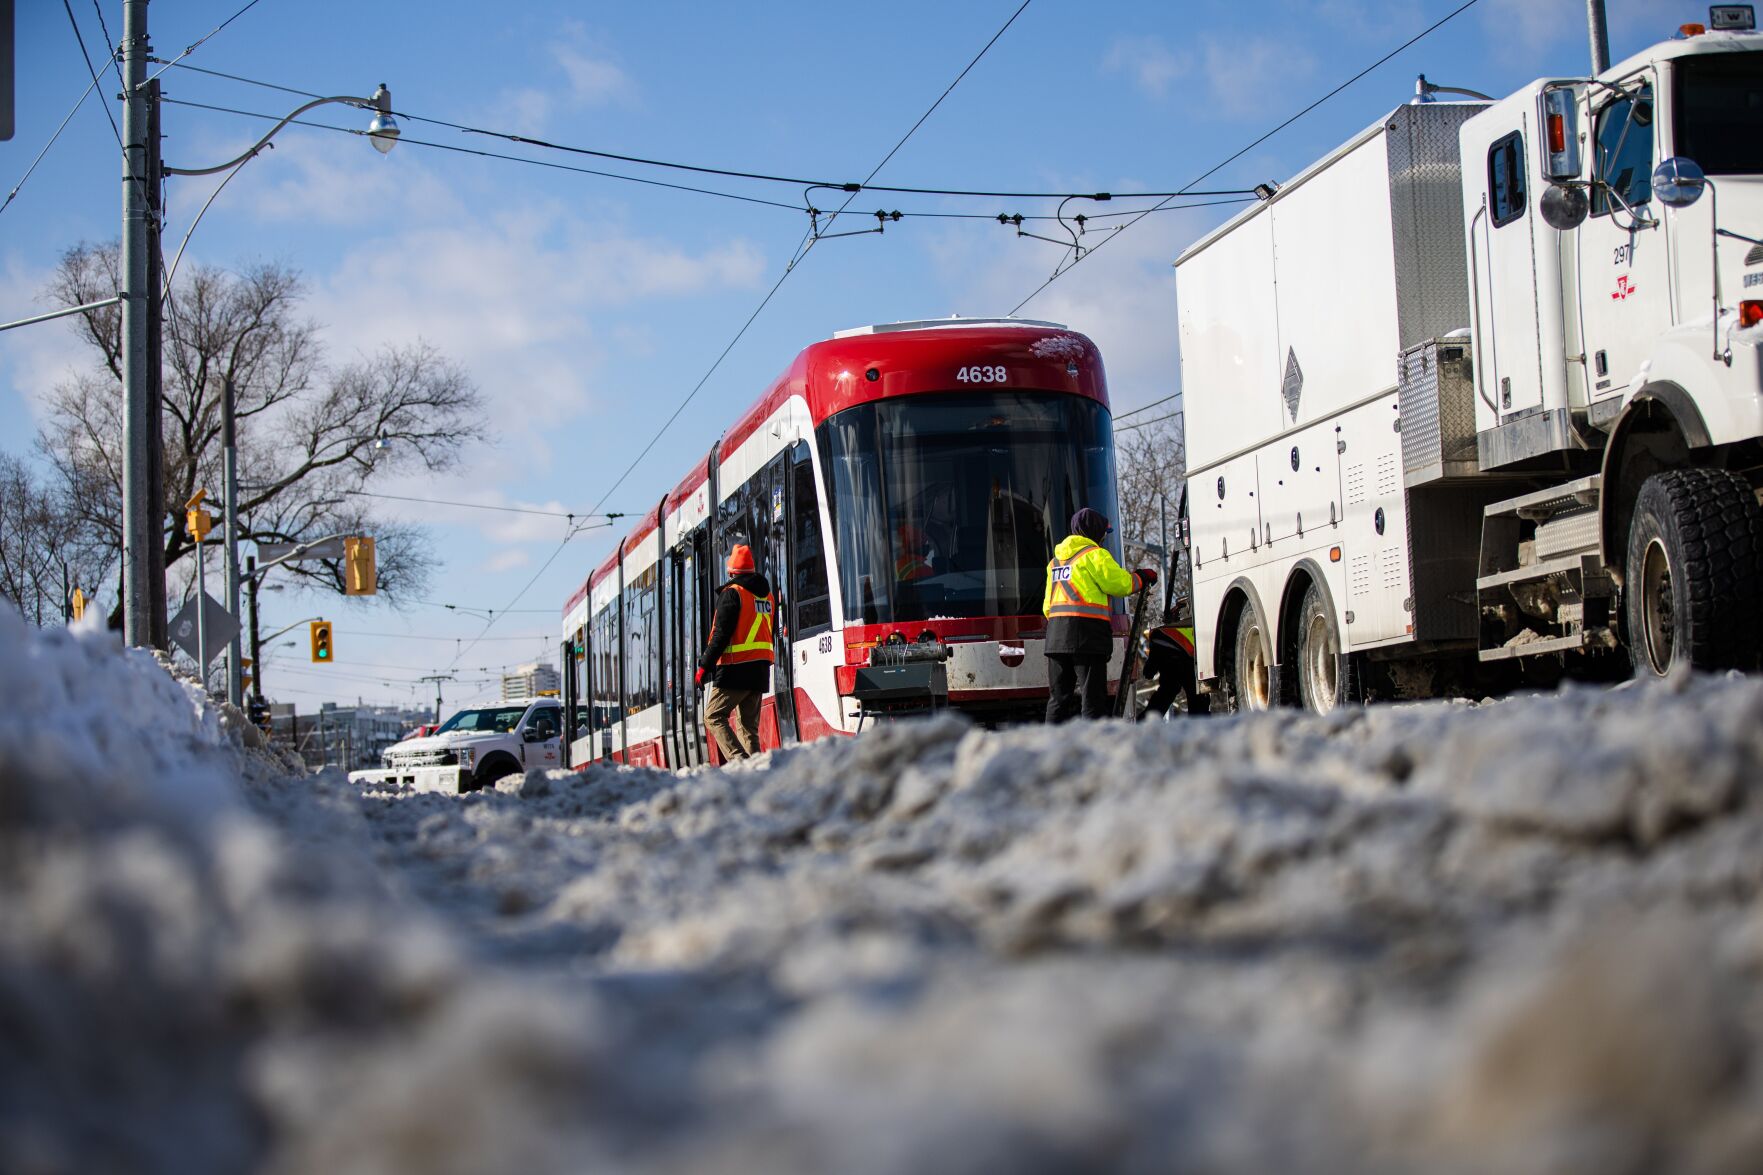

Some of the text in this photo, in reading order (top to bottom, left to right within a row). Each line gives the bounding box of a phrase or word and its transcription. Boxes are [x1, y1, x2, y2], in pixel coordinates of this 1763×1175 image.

[1613, 244, 1630, 265] 297
[956, 365, 1007, 383] 4638
[1052, 566, 1070, 581] TTC
[755, 600, 771, 613] TTC
[818, 635, 832, 655] 4638
